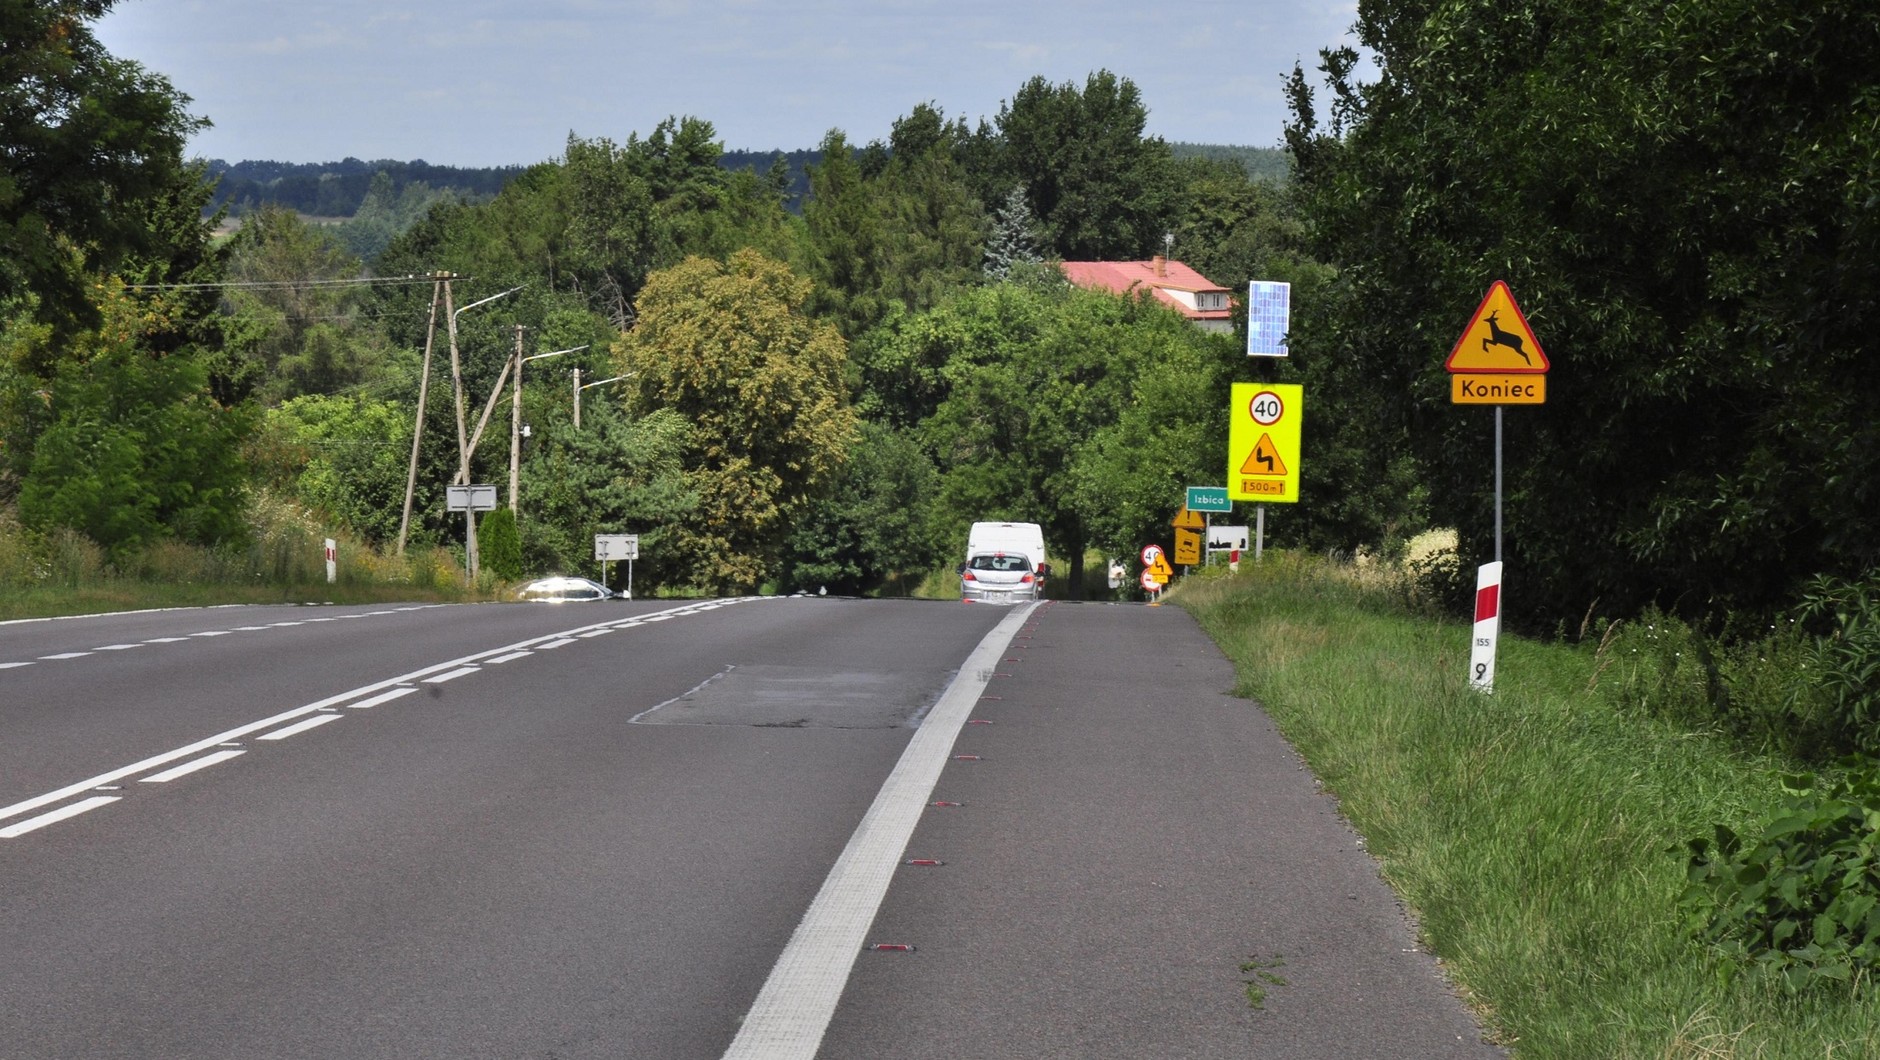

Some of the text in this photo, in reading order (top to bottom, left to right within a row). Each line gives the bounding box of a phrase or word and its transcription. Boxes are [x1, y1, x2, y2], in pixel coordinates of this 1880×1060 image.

[1462, 380, 1534, 397] Koniec
[1255, 400, 1278, 417] 40
[1195, 495, 1224, 505] Izbica
[1477, 638, 1490, 647] 155
[1476, 663, 1486, 680] 9
